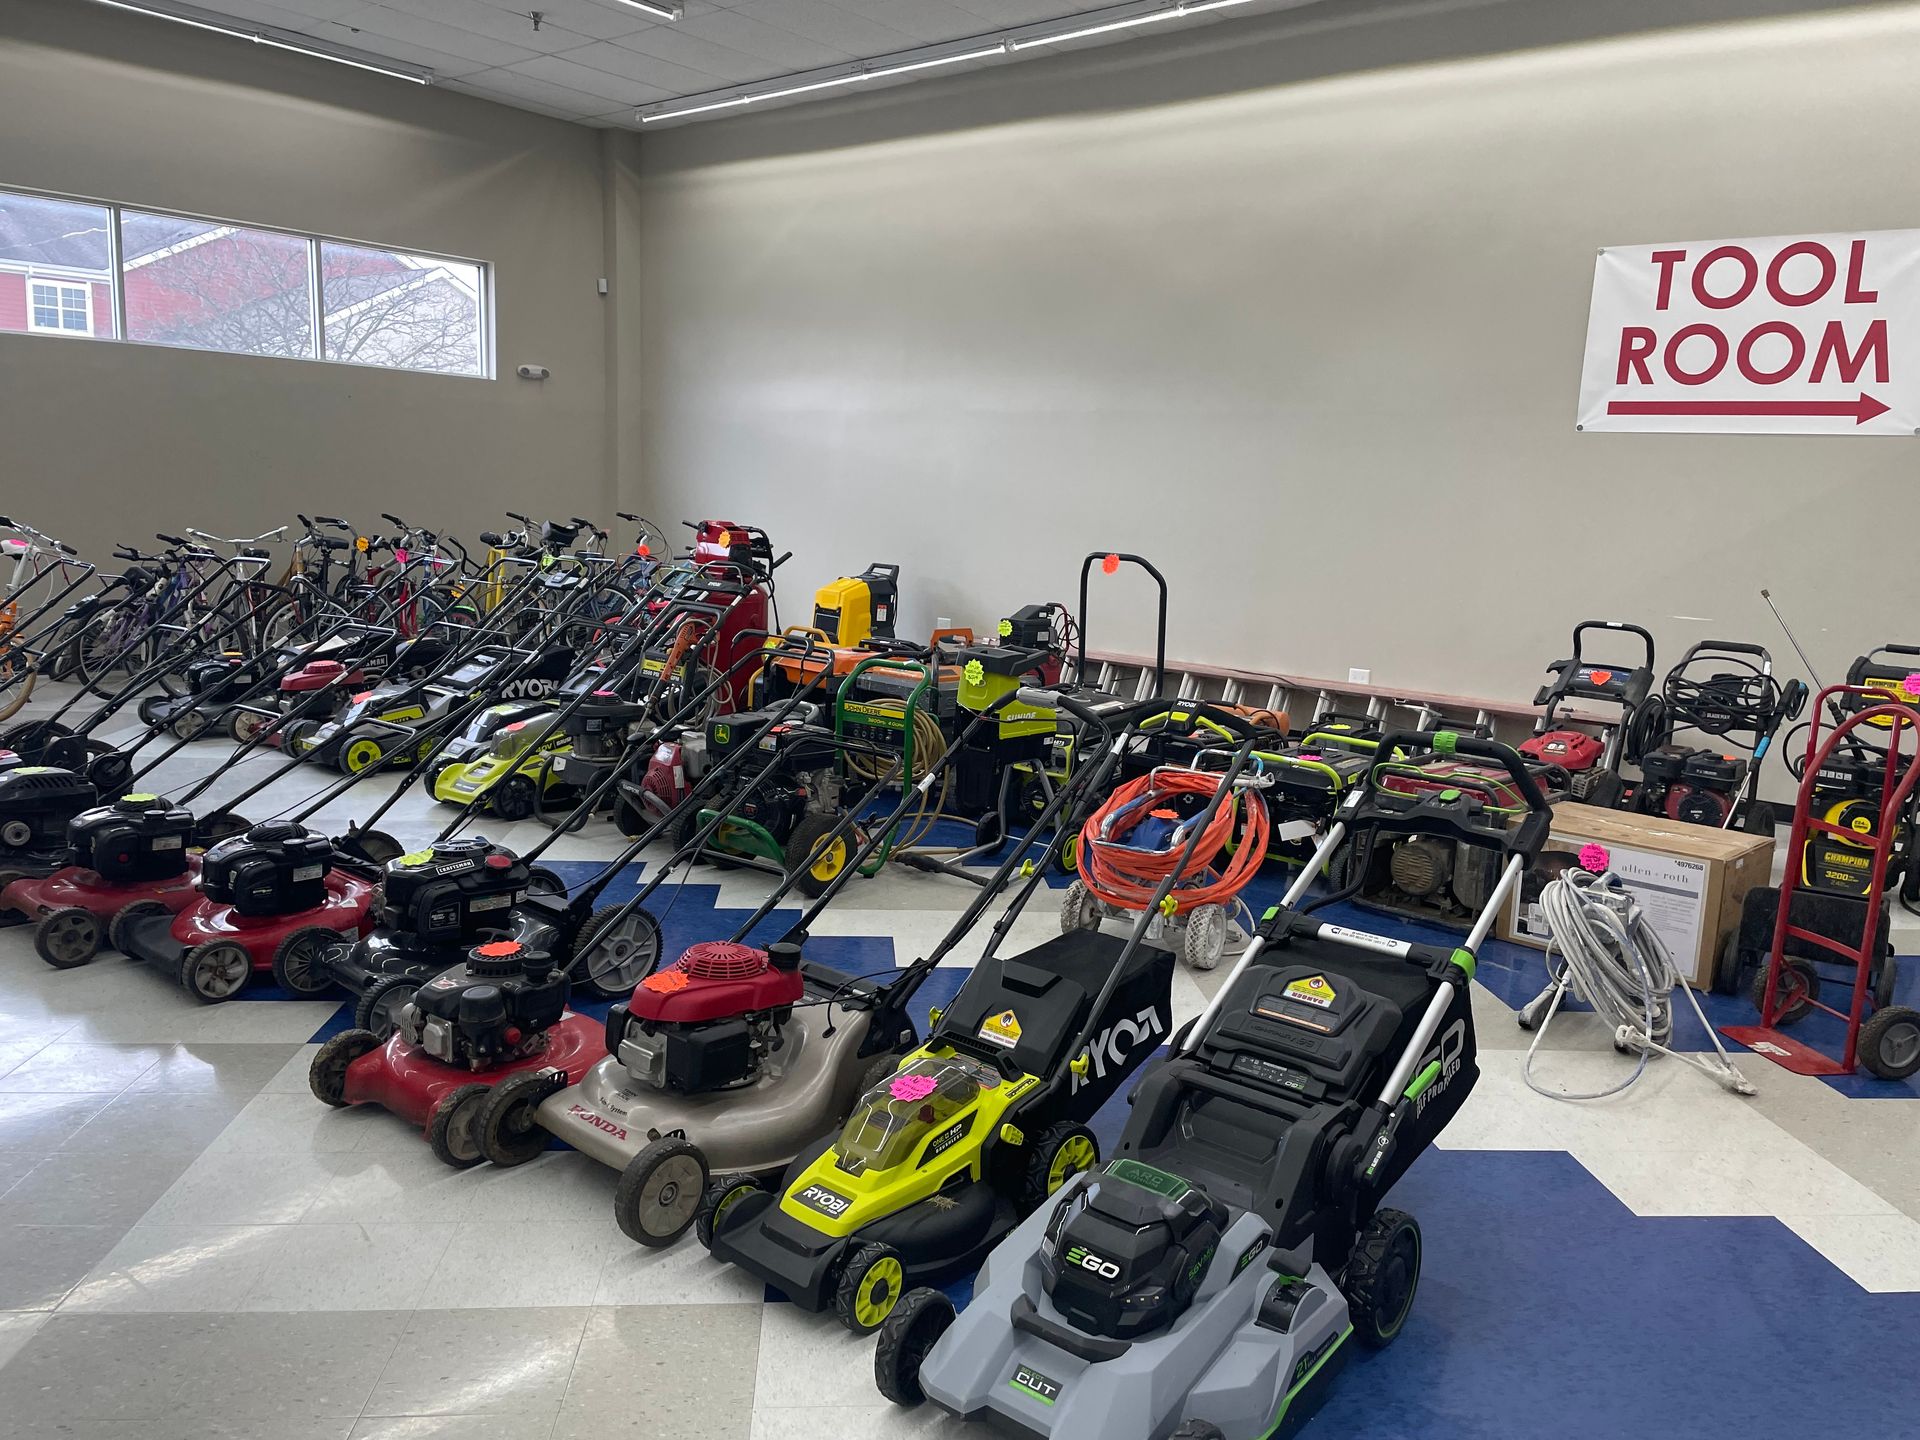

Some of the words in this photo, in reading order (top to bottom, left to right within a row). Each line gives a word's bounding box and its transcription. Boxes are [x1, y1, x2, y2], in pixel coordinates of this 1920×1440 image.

[1651, 239, 1878, 310] TOOL
[1616, 319, 1890, 386] ROOM
[846, 703, 862, 712] JOHN
[862, 707, 882, 716] DEERE
[1177, 700, 1197, 708] RYOBI
[438, 860, 473, 874] CRAFTSMAN
[1824, 852, 1869, 868] CHAMPION
[1621, 863, 1651, 876] allen
[1663, 871, 1689, 883] roth
[1825, 870, 1848, 880] 3200
[1292, 992, 1324, 1004] DANGER
[1285, 1080, 1304, 1090] EGO
[568, 1104, 628, 1141] HONDA
[950, 1124, 962, 1137] HP
[1129, 1167, 1164, 1186] ARC
[803, 1186, 849, 1213] RYOBI
[1241, 1239, 1263, 1268] EGO
[1066, 1246, 1120, 1280] EGO
[1020, 1366, 1044, 1380] SELECT
[1016, 1371, 1056, 1395] CUT
